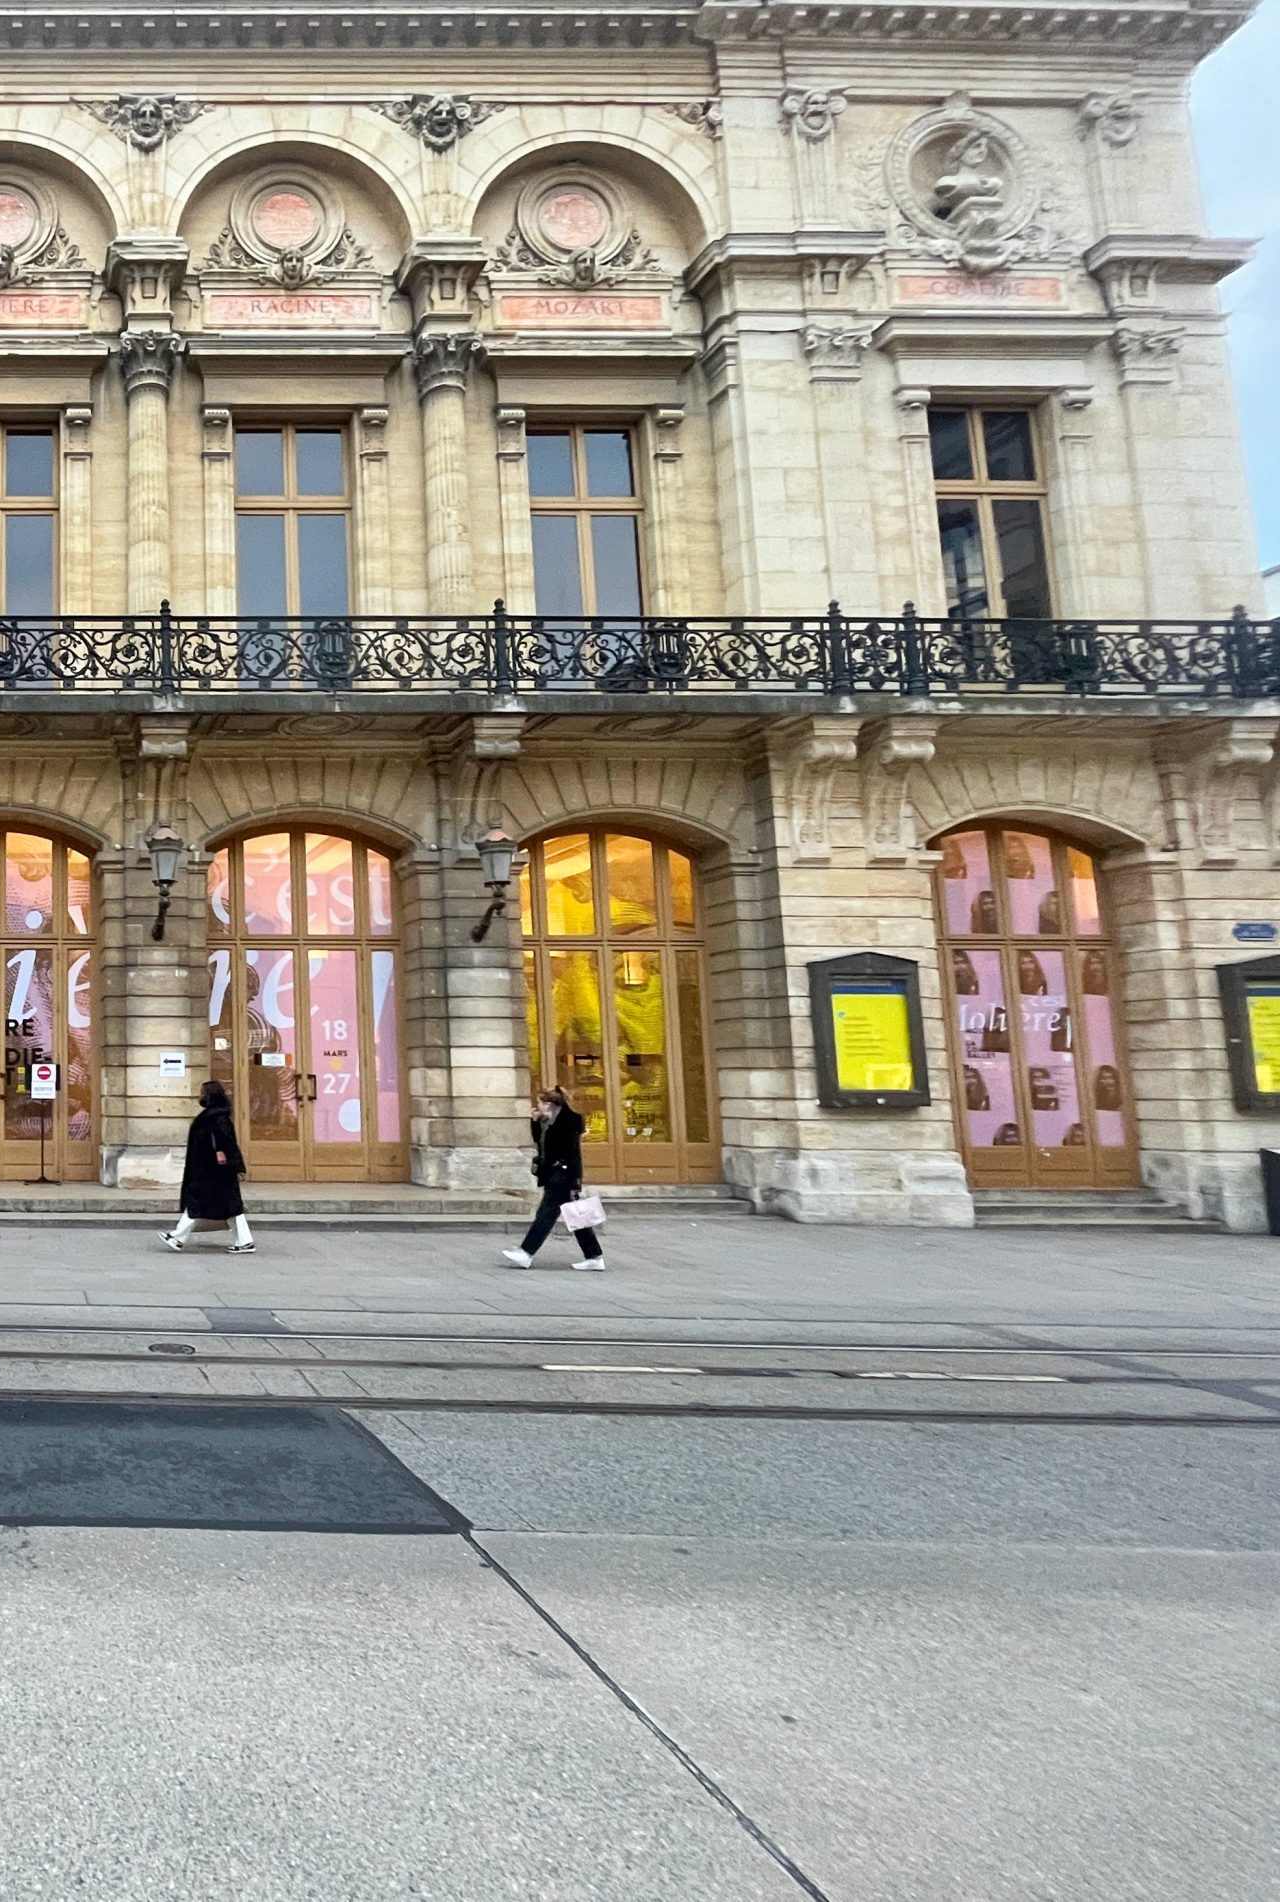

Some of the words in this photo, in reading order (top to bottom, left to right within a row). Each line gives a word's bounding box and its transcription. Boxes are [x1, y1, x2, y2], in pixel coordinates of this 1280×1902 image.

[250, 299, 332, 314] RACINE
[535, 300, 627, 315] MOZART
[211, 848, 392, 926] c'est
[322, 1019, 348, 1041] 18
[322, 1073, 351, 1094] 27
